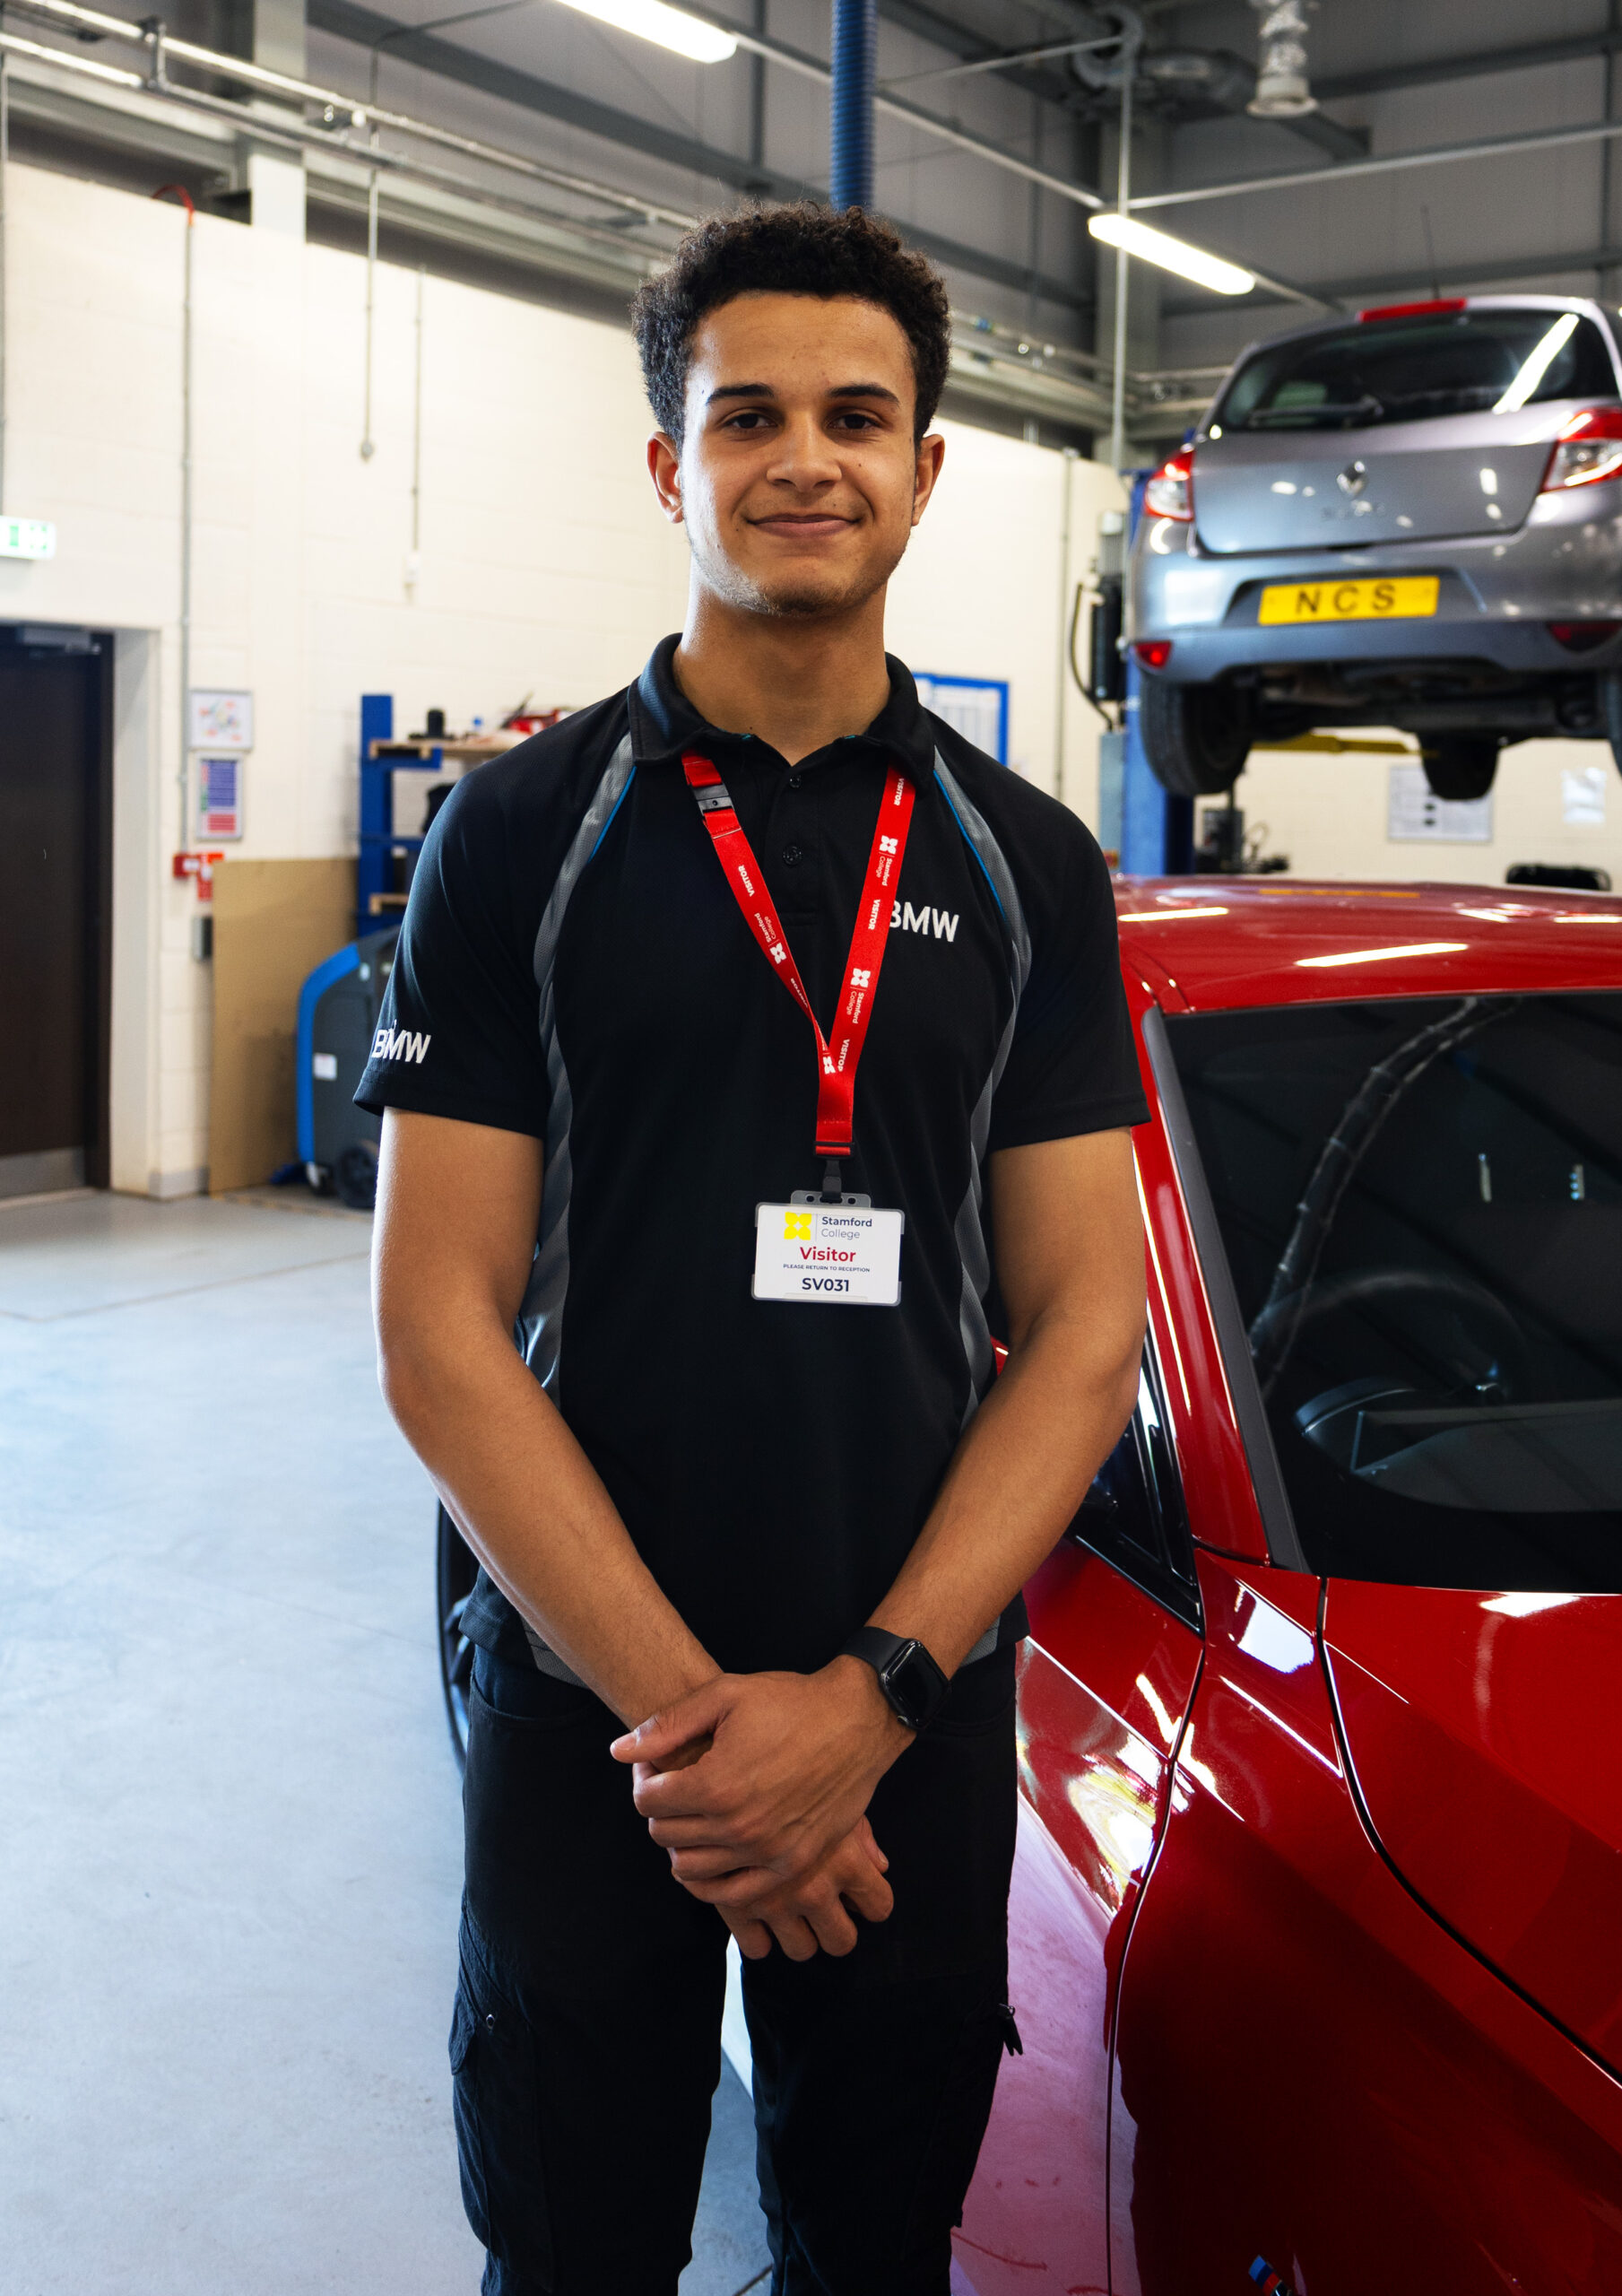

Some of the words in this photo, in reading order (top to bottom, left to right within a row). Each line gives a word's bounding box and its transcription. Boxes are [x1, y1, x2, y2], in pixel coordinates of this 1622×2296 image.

[1295, 582, 1396, 615] NCS
[893, 778, 905, 806] VISITOR
[738, 864, 755, 897] VISITOR
[875, 856, 886, 878] College
[881, 857, 893, 887] Stamford
[754, 912, 772, 943] Stamford
[764, 916, 776, 940] College
[868, 899, 880, 930] VISITOR
[889, 900, 959, 943] BMW
[846, 990, 857, 1015] College
[852, 992, 864, 1024] Stamford
[371, 1028, 432, 1064] BMW
[820, 1228, 861, 1240] College
[821, 1216, 872, 1228] Stamford
[800, 1246, 856, 1262] Visitor
[802, 1277, 849, 1292] SV031
